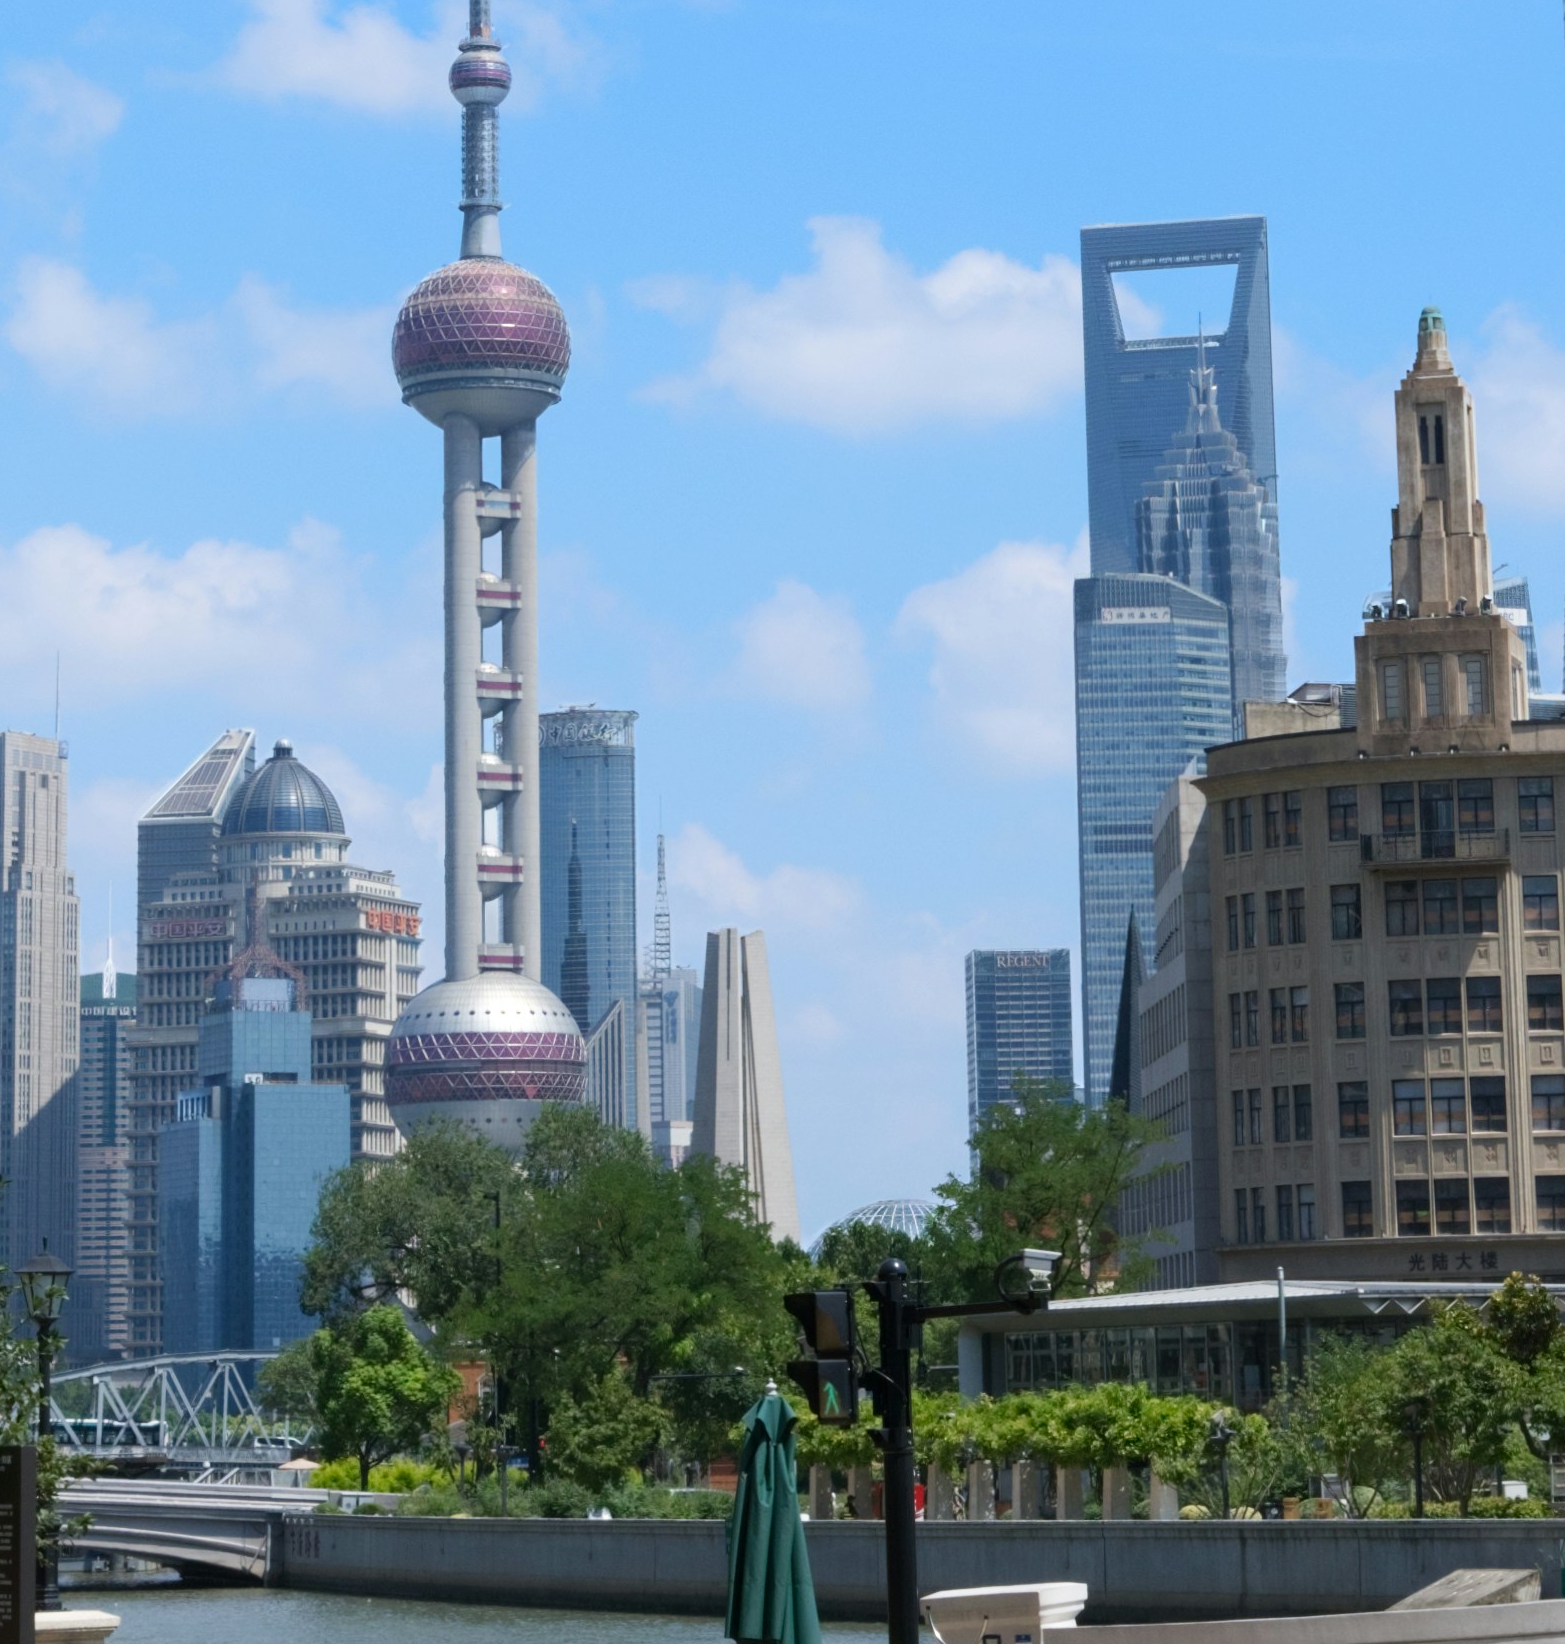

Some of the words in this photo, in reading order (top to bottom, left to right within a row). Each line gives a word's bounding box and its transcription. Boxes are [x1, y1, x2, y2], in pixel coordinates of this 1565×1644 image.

[151, 920, 224, 938] 中国平安
[366, 908, 421, 936] 中国平安
[997, 955, 1049, 968] REGENT
[1408, 1251, 1498, 1272] 光陆大楼
